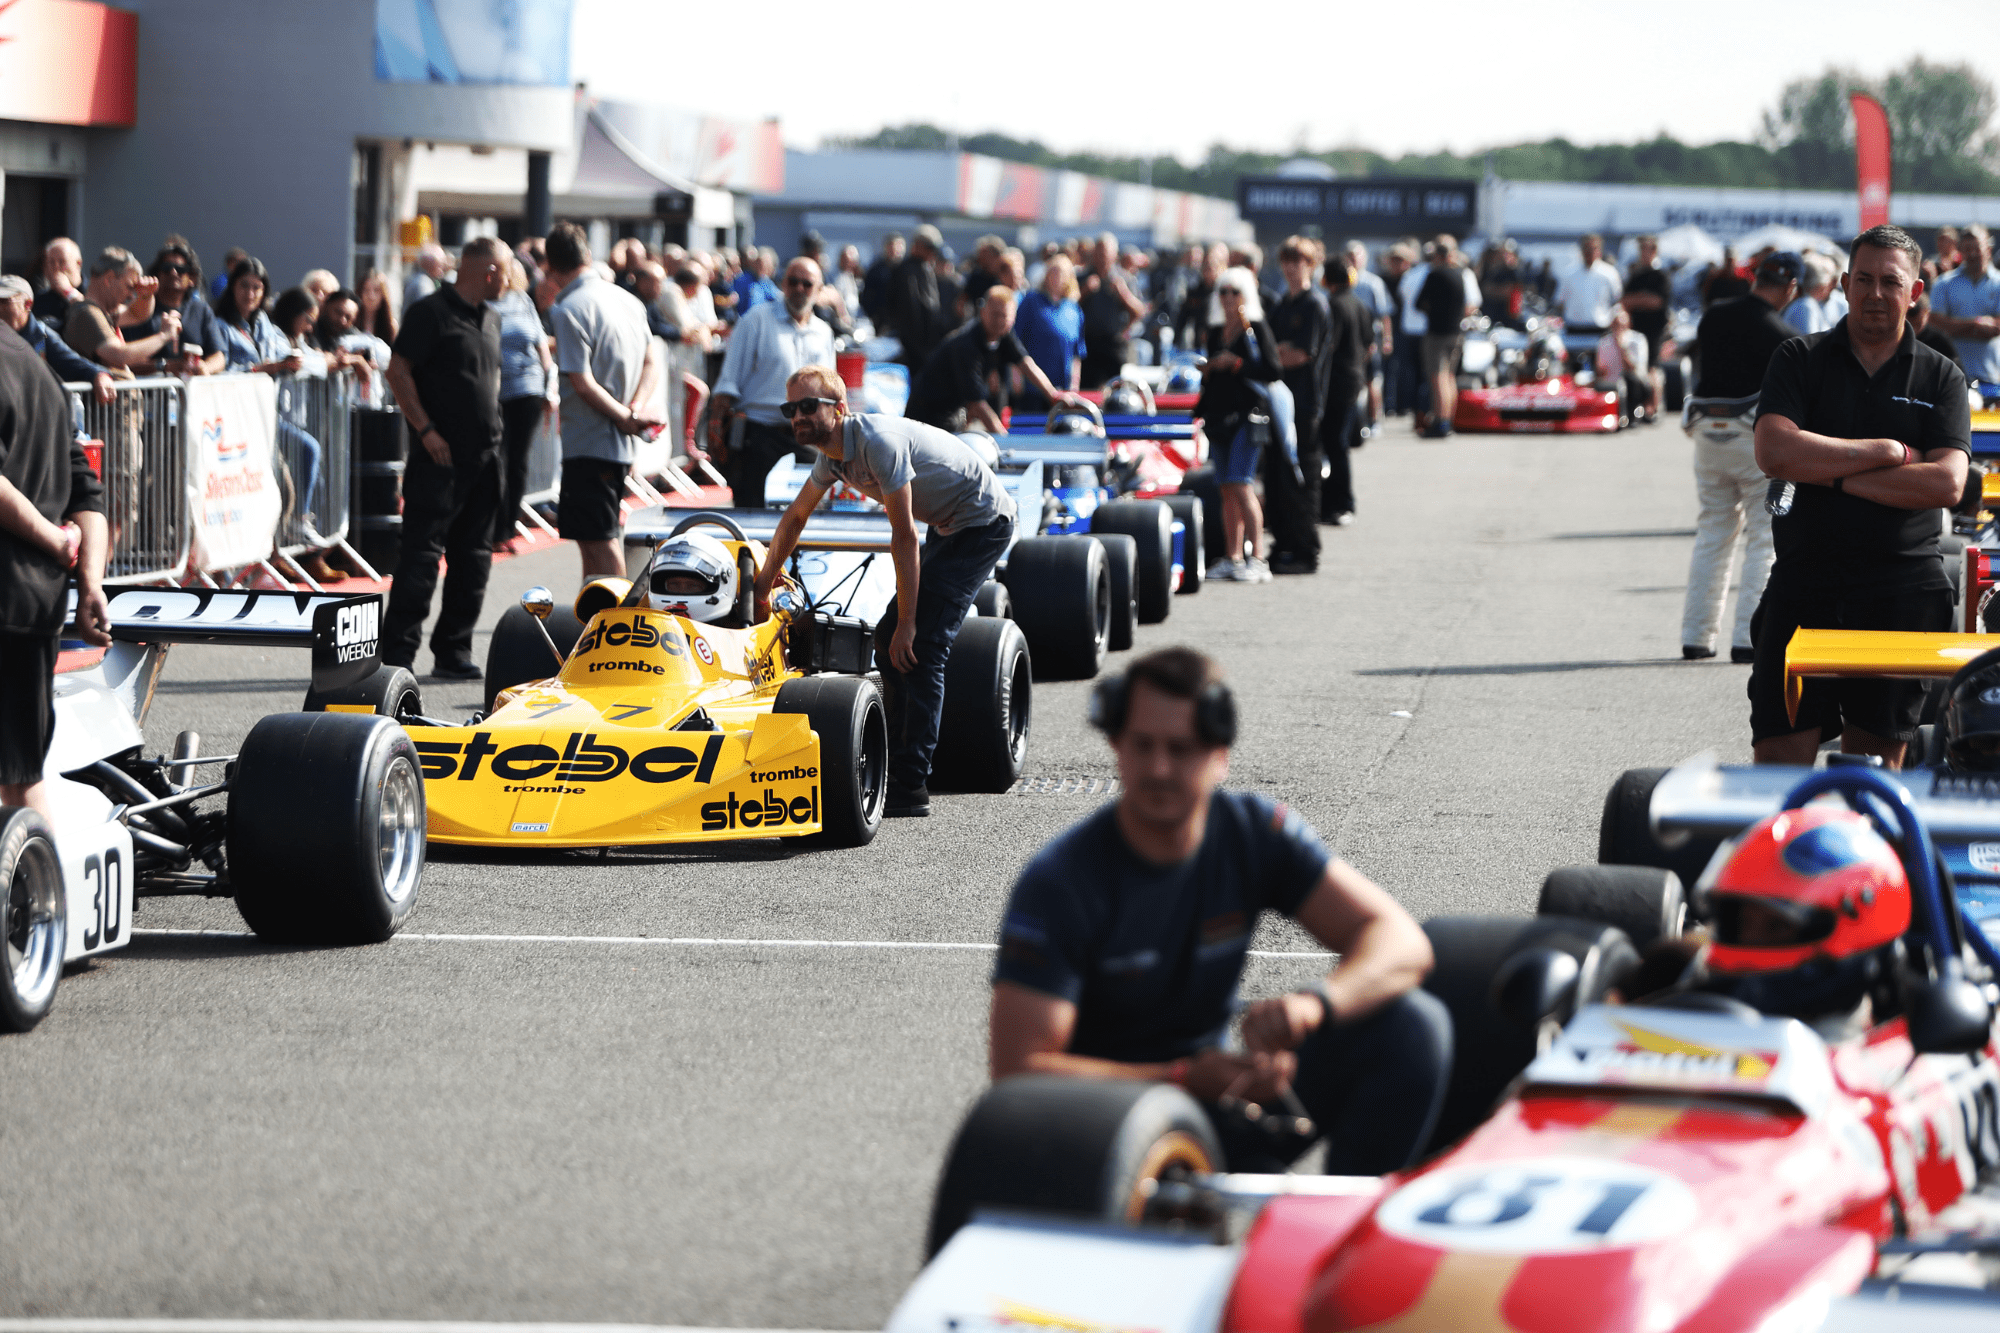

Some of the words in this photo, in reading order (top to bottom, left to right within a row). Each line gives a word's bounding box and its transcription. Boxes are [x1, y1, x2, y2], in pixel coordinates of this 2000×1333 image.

[337, 601, 379, 647] COIN
[338, 640, 379, 664] WEEKLY
[588, 660, 666, 676] trombe
[415, 732, 725, 785] stebel
[750, 766, 818, 783] trombe
[503, 785, 586, 795] trombe
[701, 785, 818, 831] stebel
[84, 847, 121, 951] 30
